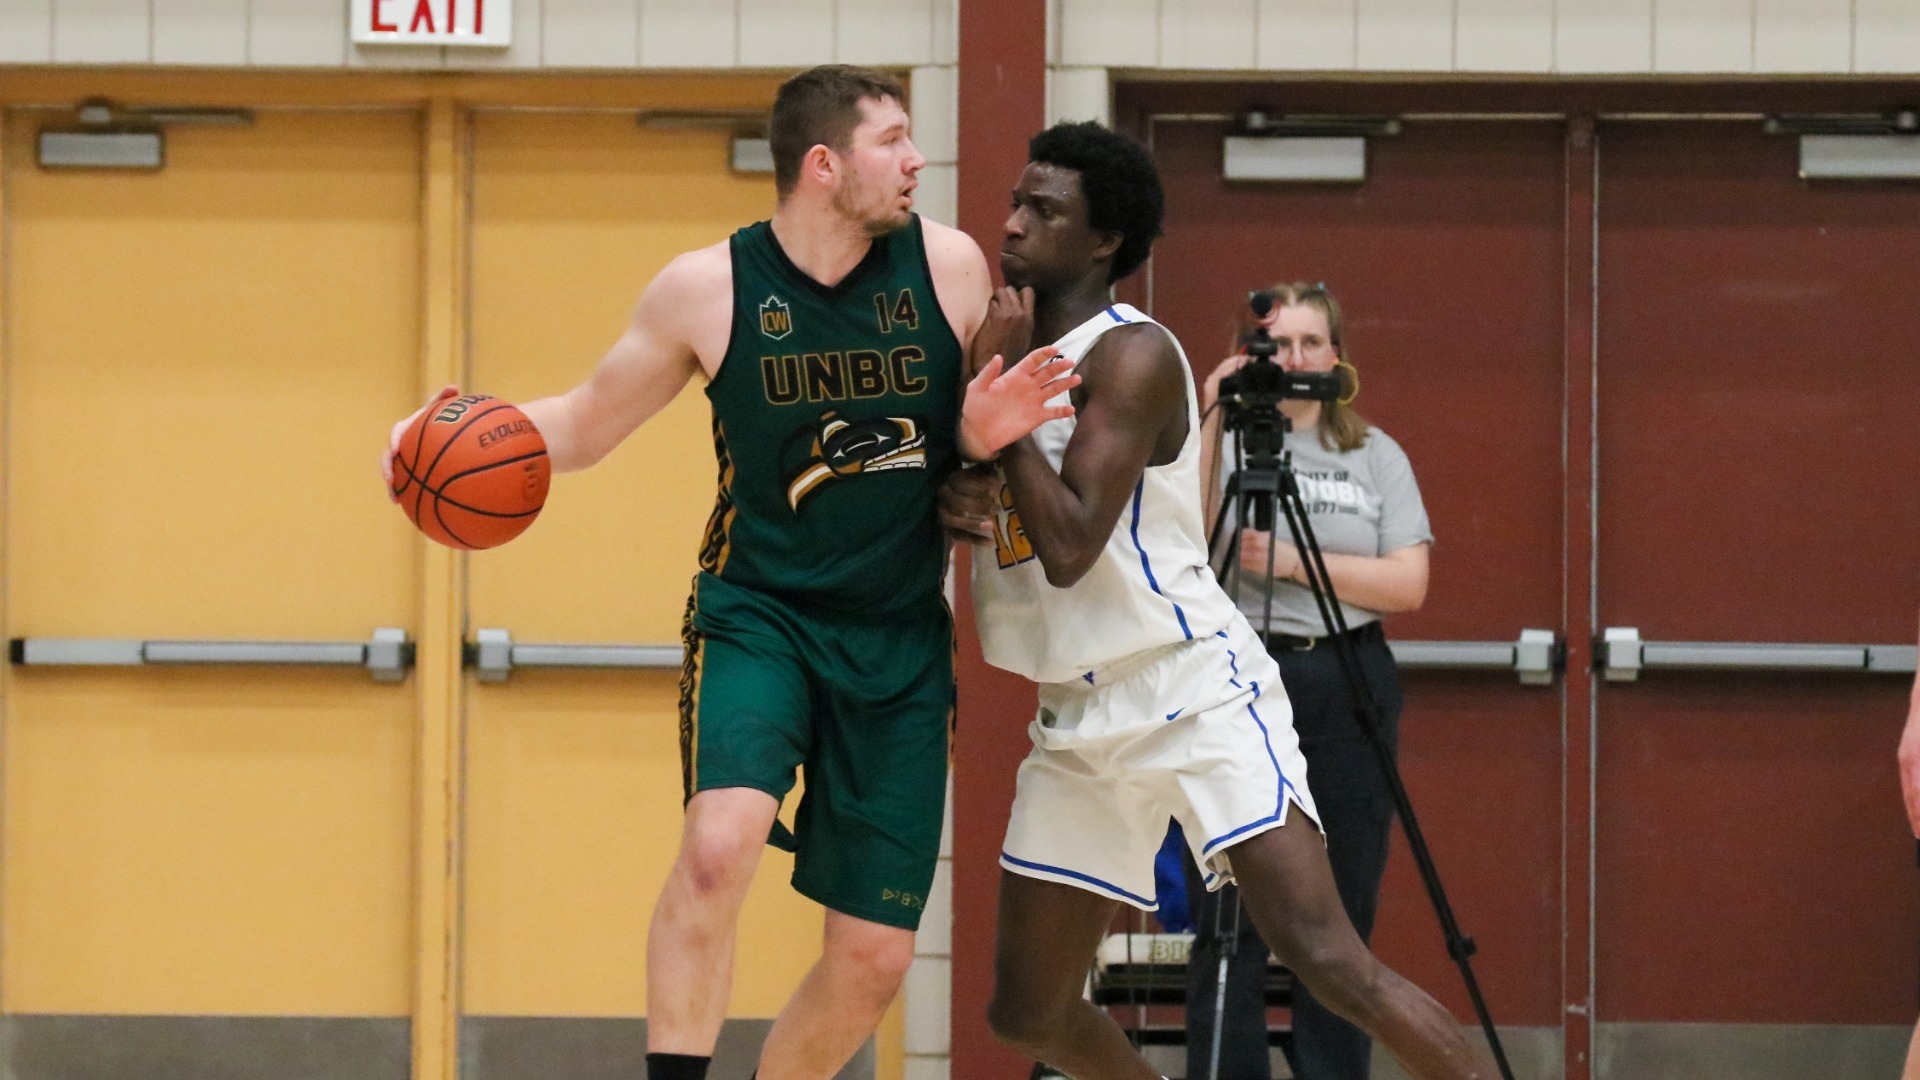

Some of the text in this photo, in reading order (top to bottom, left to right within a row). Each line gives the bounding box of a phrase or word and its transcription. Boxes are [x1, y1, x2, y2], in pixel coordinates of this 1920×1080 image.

[763, 311, 787, 332] CW
[873, 288, 918, 334] 14
[760, 345, 928, 406] UNBC
